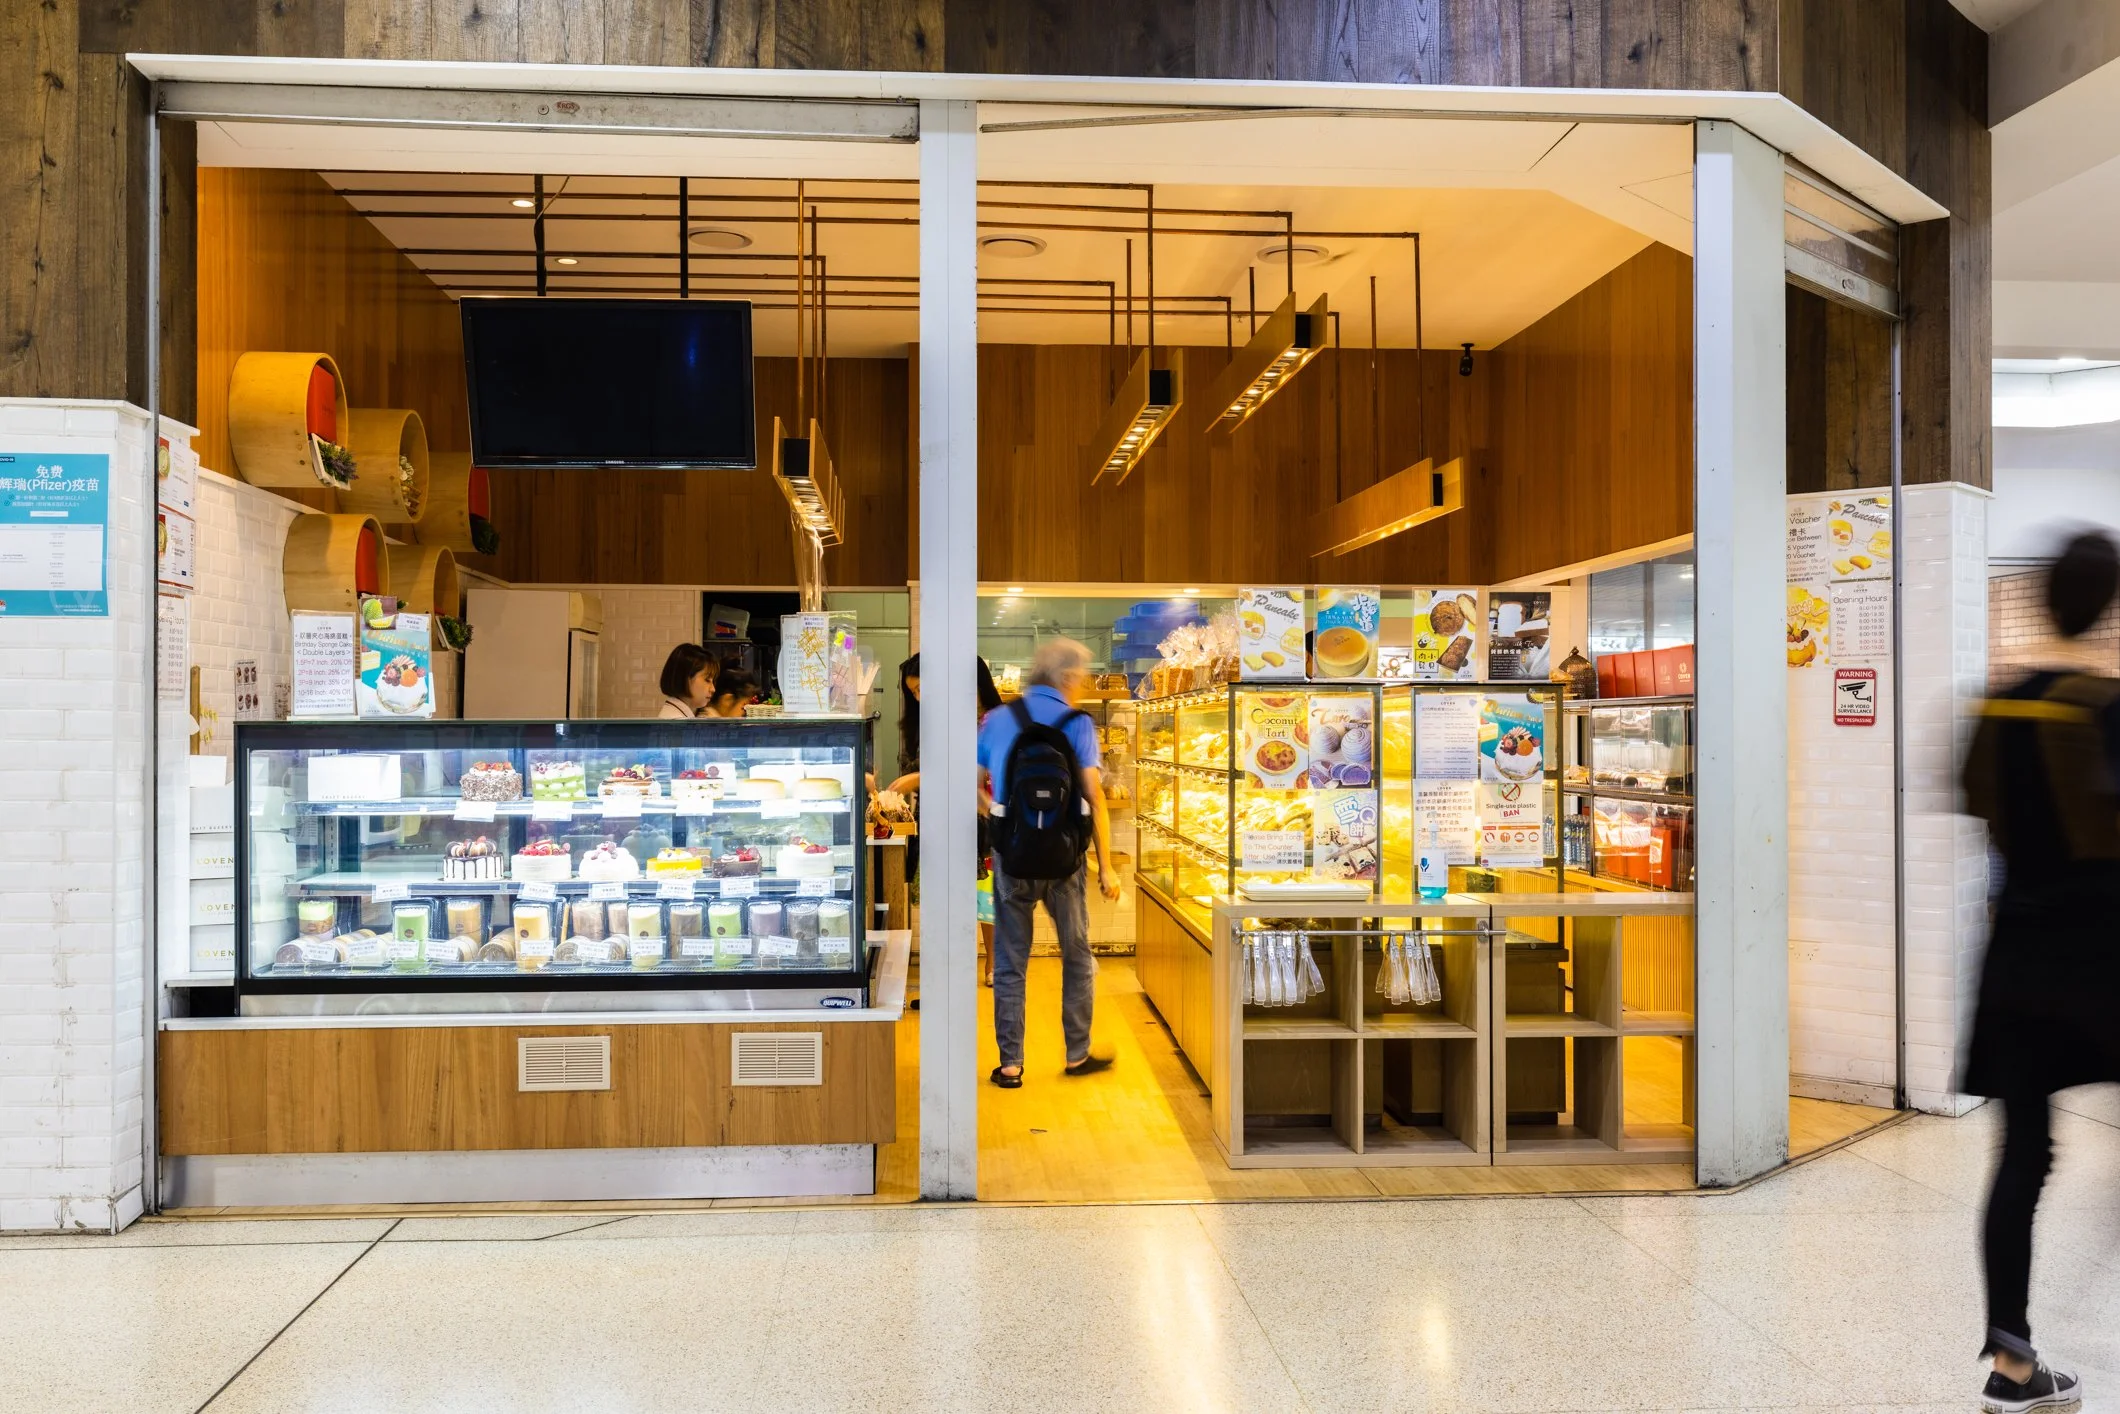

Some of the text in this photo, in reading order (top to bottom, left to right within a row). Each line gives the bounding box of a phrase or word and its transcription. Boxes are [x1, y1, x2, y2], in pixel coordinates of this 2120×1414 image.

[36, 464, 64, 478] 免费
[1790, 516, 1821, 524] Voucher
[1841, 504, 1886, 525] Pancake
[1253, 594, 1300, 620] Pancake
[325, 649, 345, 657] Layers
[1251, 708, 1298, 724] Coconut
[1311, 708, 1350, 725] Taro
[1266, 728, 1285, 737] Tart
[1503, 809, 1520, 817] BAN
